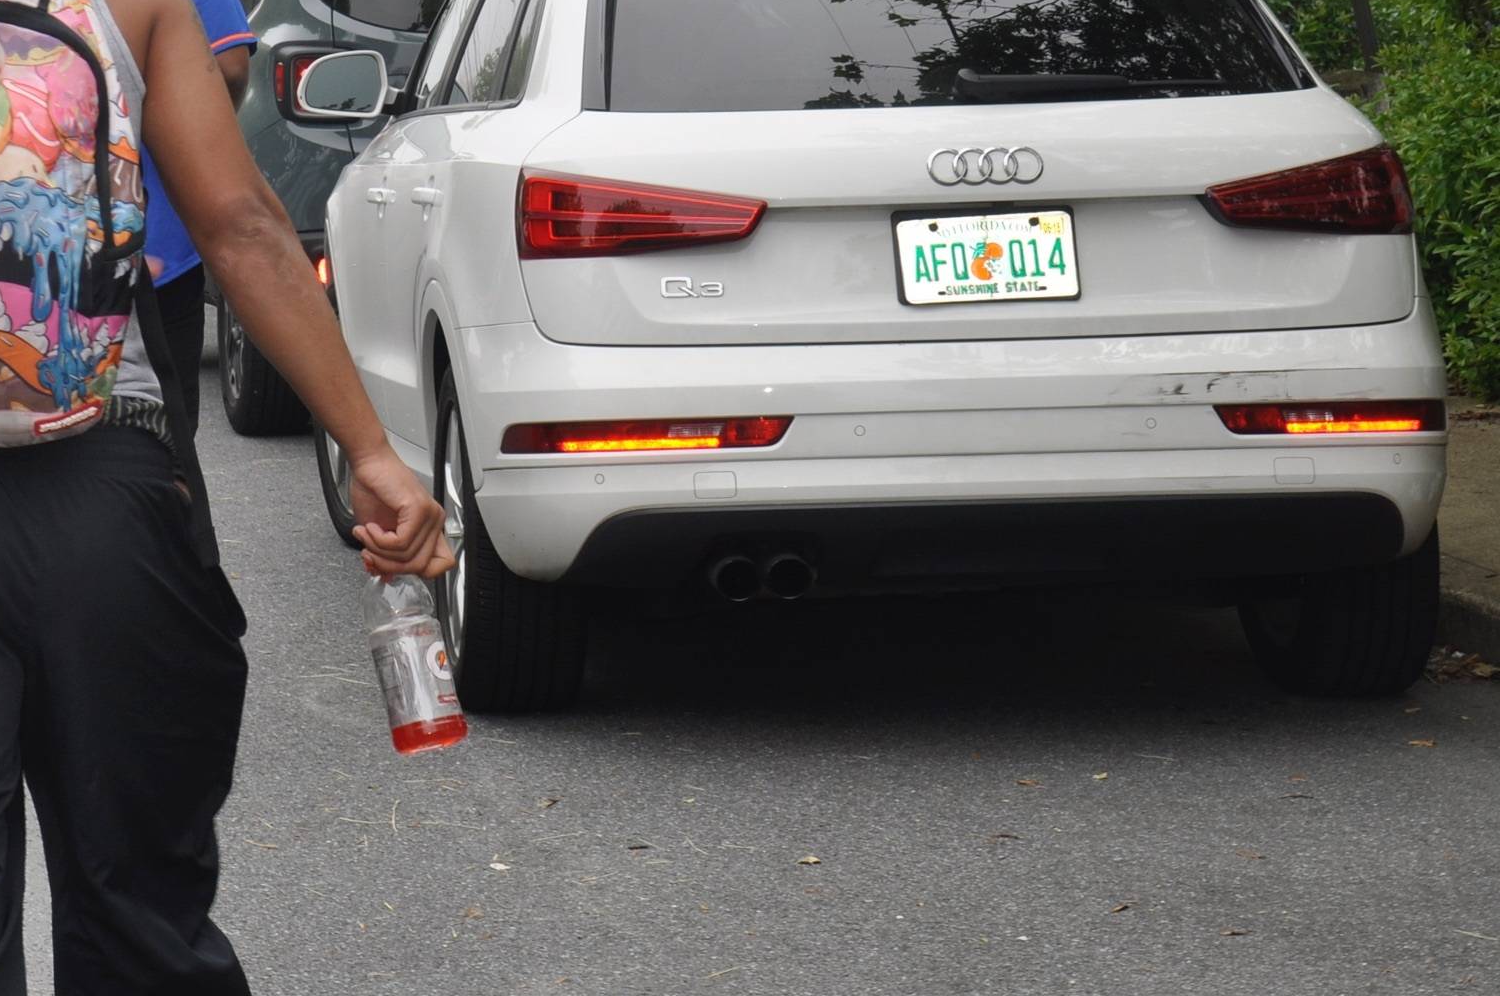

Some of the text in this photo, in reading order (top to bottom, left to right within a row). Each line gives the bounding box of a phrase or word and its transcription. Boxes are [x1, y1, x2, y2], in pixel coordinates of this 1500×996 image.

[915, 237, 1066, 282] AFQ Q14
[660, 276, 724, 298] Q3
[946, 281, 1041, 296] SUNSHINE STATE
